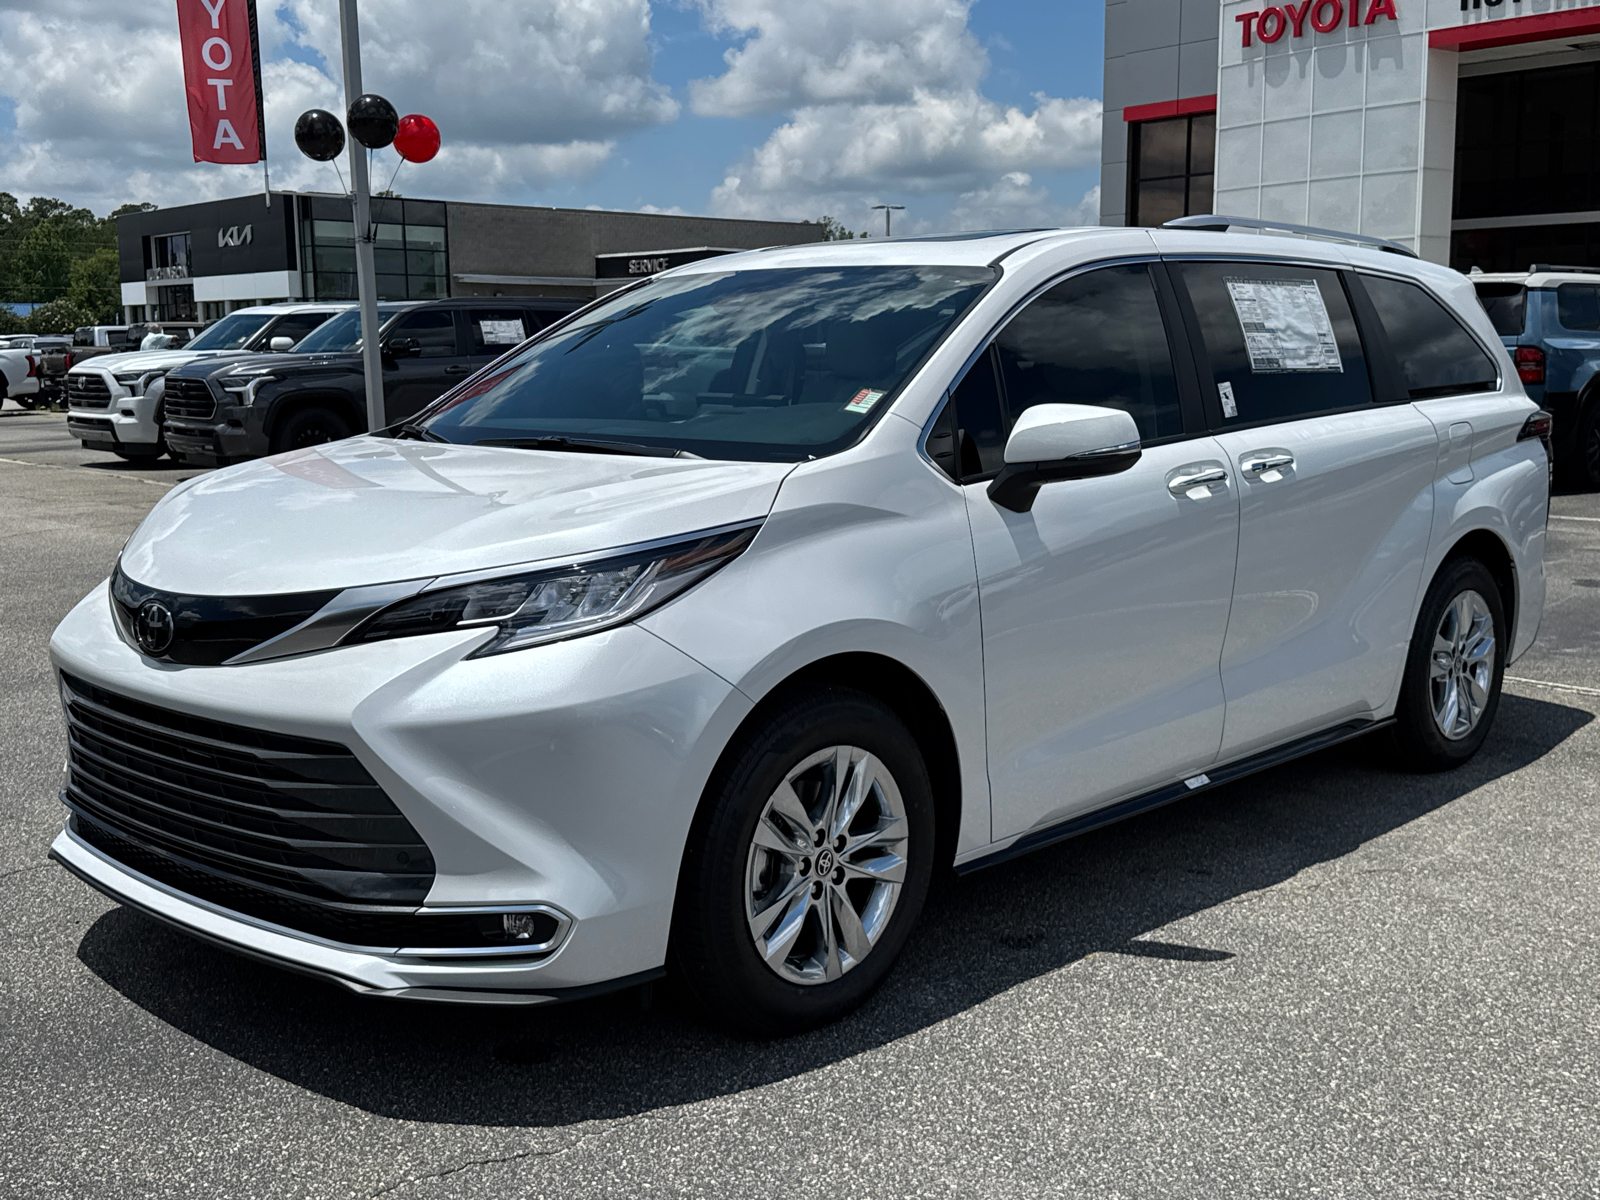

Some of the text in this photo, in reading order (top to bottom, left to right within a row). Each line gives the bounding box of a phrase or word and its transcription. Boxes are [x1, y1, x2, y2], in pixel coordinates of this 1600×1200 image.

[1235, 0, 1397, 48] TOYOTA
[217, 224, 252, 248] KIA
[628, 257, 669, 273] SERVICE
